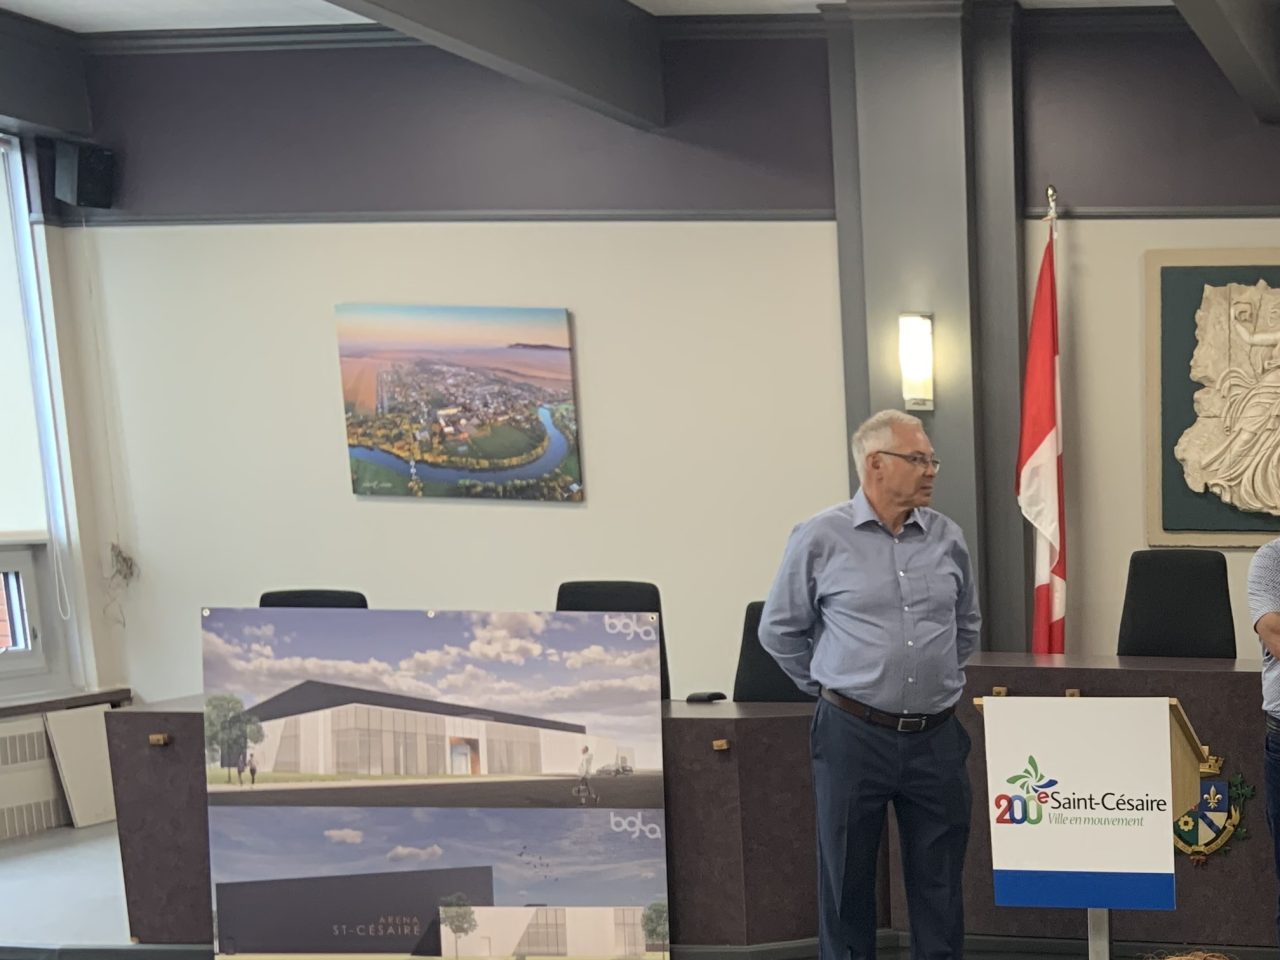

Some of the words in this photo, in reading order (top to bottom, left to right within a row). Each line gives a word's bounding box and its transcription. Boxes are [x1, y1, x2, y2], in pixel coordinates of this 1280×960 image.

[1050, 791, 1167, 811] Saint-Césaire
[610, 811, 661, 839] bgla
[1048, 813, 1068, 825] Ville
[1069, 816, 1082, 825] en
[1084, 815, 1144, 827] mouvement
